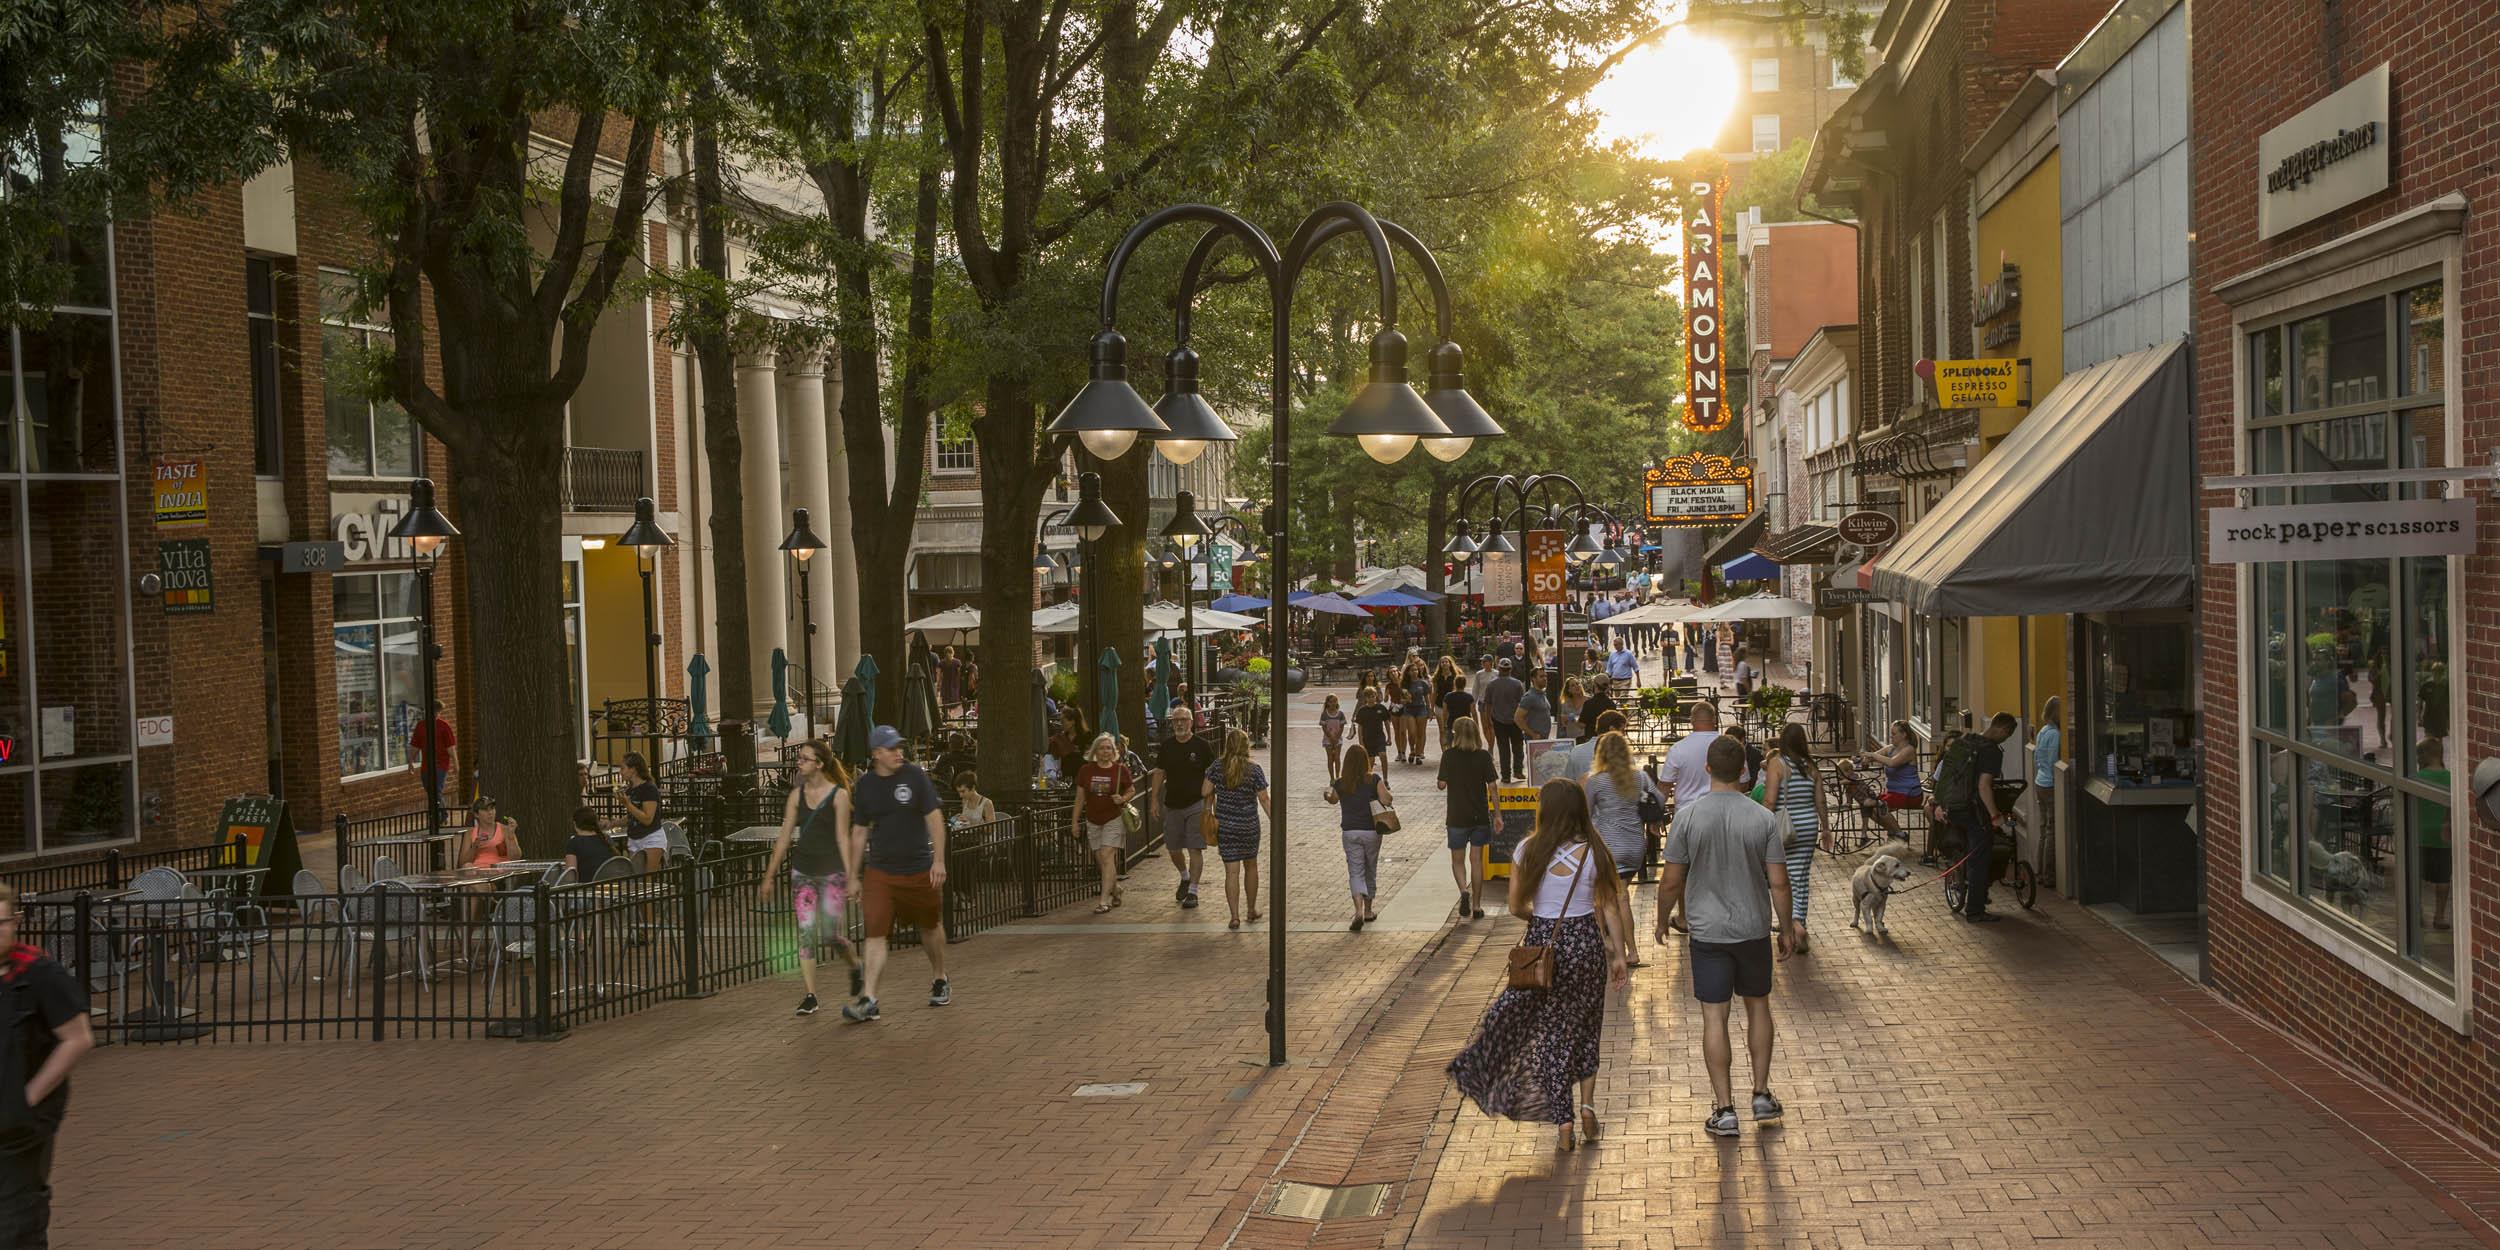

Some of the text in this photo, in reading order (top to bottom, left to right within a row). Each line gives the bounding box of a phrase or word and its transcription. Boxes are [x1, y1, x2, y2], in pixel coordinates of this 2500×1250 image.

[1690, 181, 1717, 418] PARAMOUNT
[1943, 361, 2012, 378] SPLENDORA'S
[1951, 381, 2007, 391] ESPRESSO
[1951, 393, 1997, 402] GELATO
[156, 463, 198, 481] TASTE
[159, 491, 202, 508] INDIA
[1691, 496, 1726, 504] FESTIVAL
[1686, 505, 1706, 513] JUNE
[1848, 518, 1889, 528] Kilwins
[162, 543, 207, 569] vita
[303, 548, 327, 567] 308
[164, 569, 209, 589] nova
[1214, 571, 1229, 582] 50
[1533, 573, 1561, 592] 50
[139, 718, 171, 736] FDC
[235, 807, 267, 815] PIZZA
[238, 815, 272, 823] PASTA
